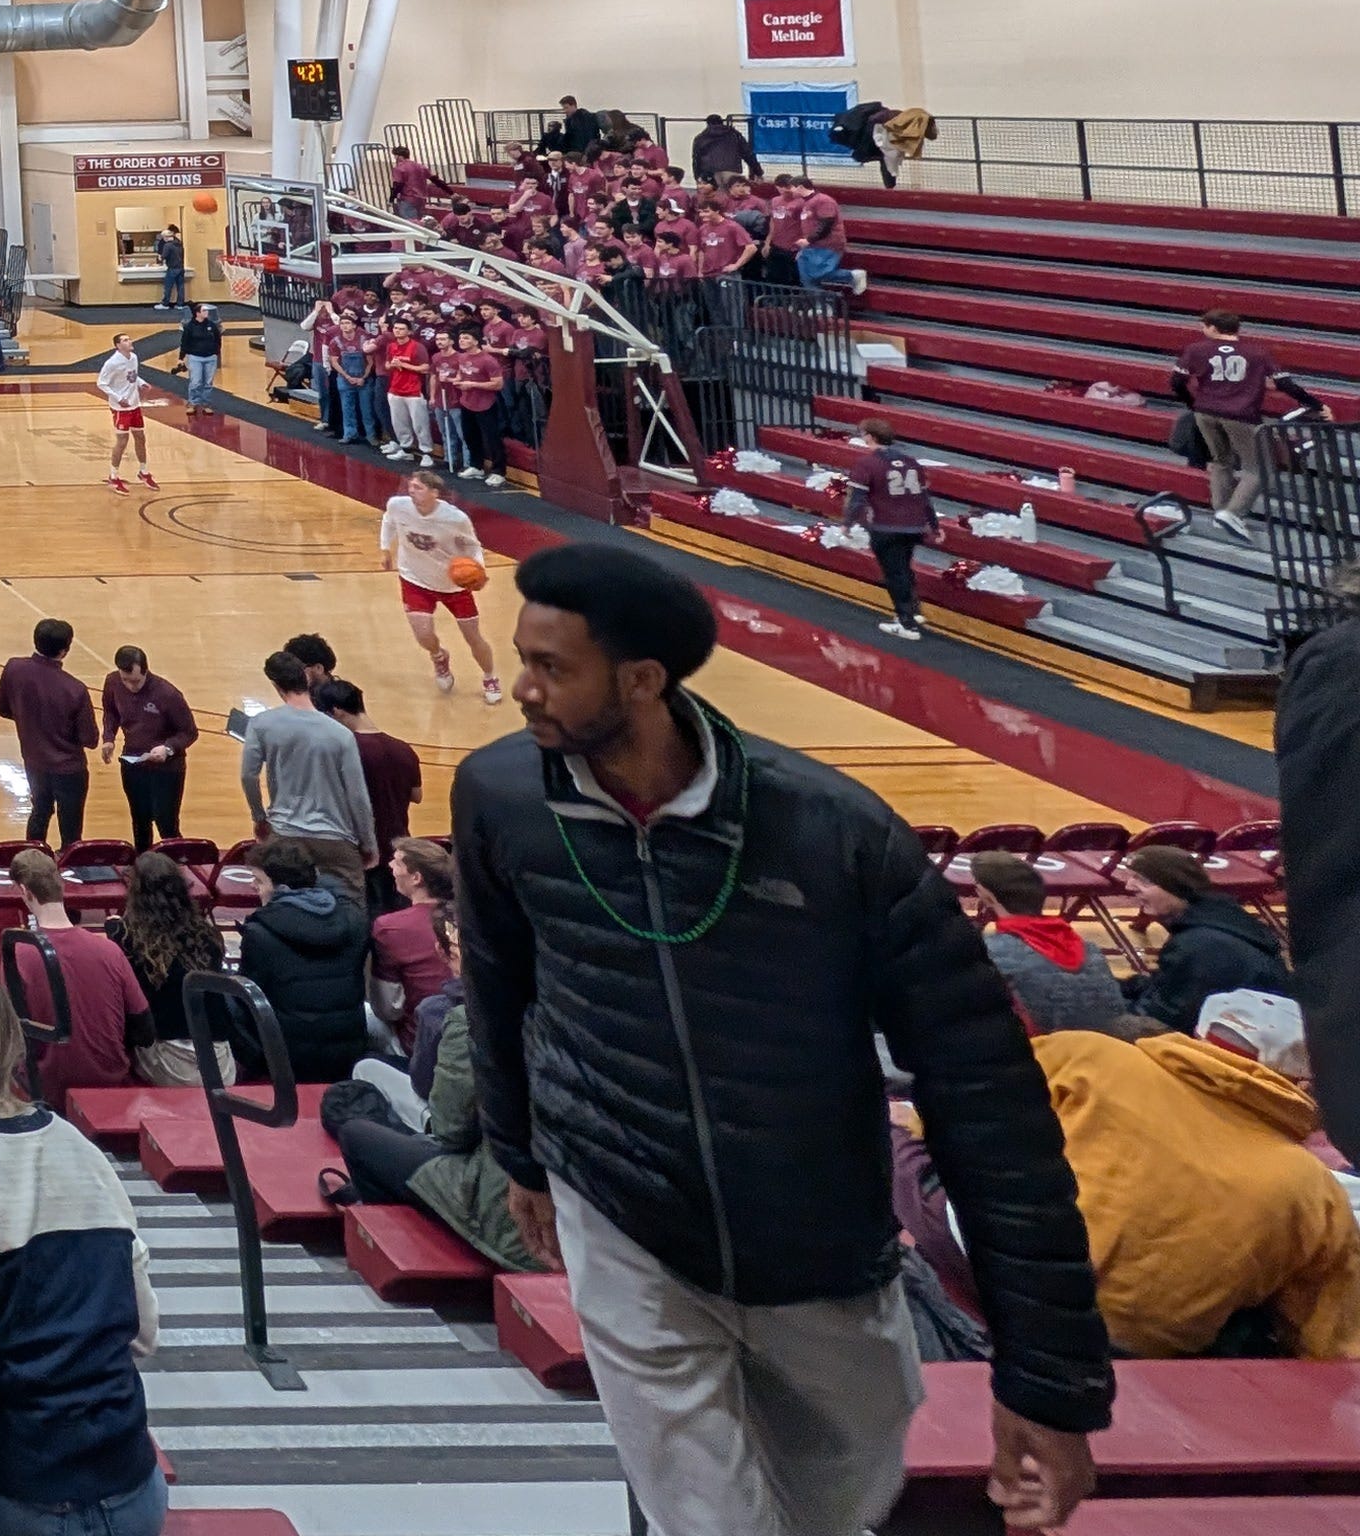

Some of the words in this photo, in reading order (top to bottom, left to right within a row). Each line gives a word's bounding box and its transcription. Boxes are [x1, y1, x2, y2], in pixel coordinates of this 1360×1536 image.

[763, 11, 823, 29] Carnegie
[771, 30, 815, 42] Mellon
[297, 64, 324, 82] 4:27
[757, 116, 788, 128] Case
[789, 116, 835, 130] Rserv
[87, 157, 112, 170] THE
[113, 156, 156, 169] ORDER
[158, 156, 175, 168] OF
[177, 155, 202, 168] THE
[97, 173, 202, 188] CONCESSIONS
[1208, 355, 1247, 382] 10
[886, 469, 922, 495] 24
